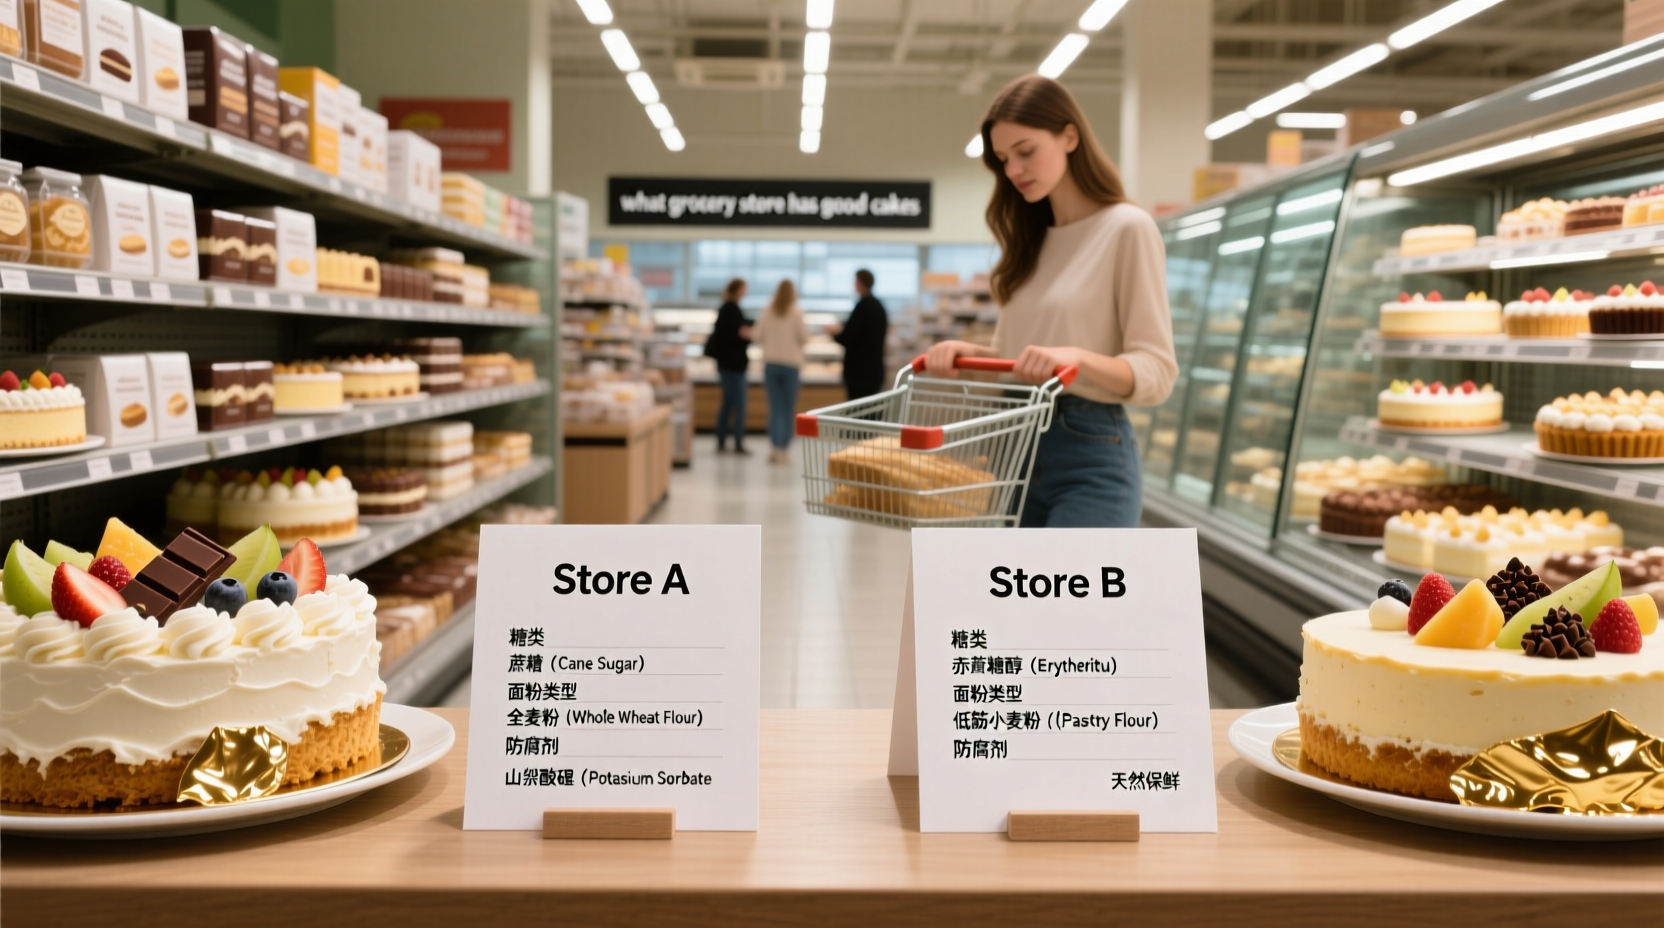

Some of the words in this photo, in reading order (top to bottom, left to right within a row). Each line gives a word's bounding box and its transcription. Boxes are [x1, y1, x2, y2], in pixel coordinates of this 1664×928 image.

[620, 191, 666, 212] what
[668, 195, 737, 218] grocery
[739, 194, 786, 214] store
[787, 192, 819, 214] has
[819, 192, 868, 219] good
[869, 193, 921, 216] cakes
[553, 563, 652, 594] Store
[661, 564, 689, 594] A
[990, 566, 1089, 598] Store
[1102, 567, 1126, 598] B
[509, 627, 544, 646] 糖类
[951, 629, 987, 649] 糖类
[551, 655, 593, 672] (Cane
[598, 655, 644, 674] Sugar)
[508, 682, 576, 701] 面粉类型
[953, 684, 1022, 703] 面粉类型
[507, 707, 559, 727] 全麦粉
[567, 709, 614, 726] (Whole
[619, 710, 659, 724] Wheat
[664, 710, 702, 726] Flour)
[953, 711, 1040, 730] 低筋小麦粉
[1115, 712, 1157, 729] Flour)
[658, 771, 711, 785] Sorbate
[1112, 771, 1180, 790] 天然保鲜
